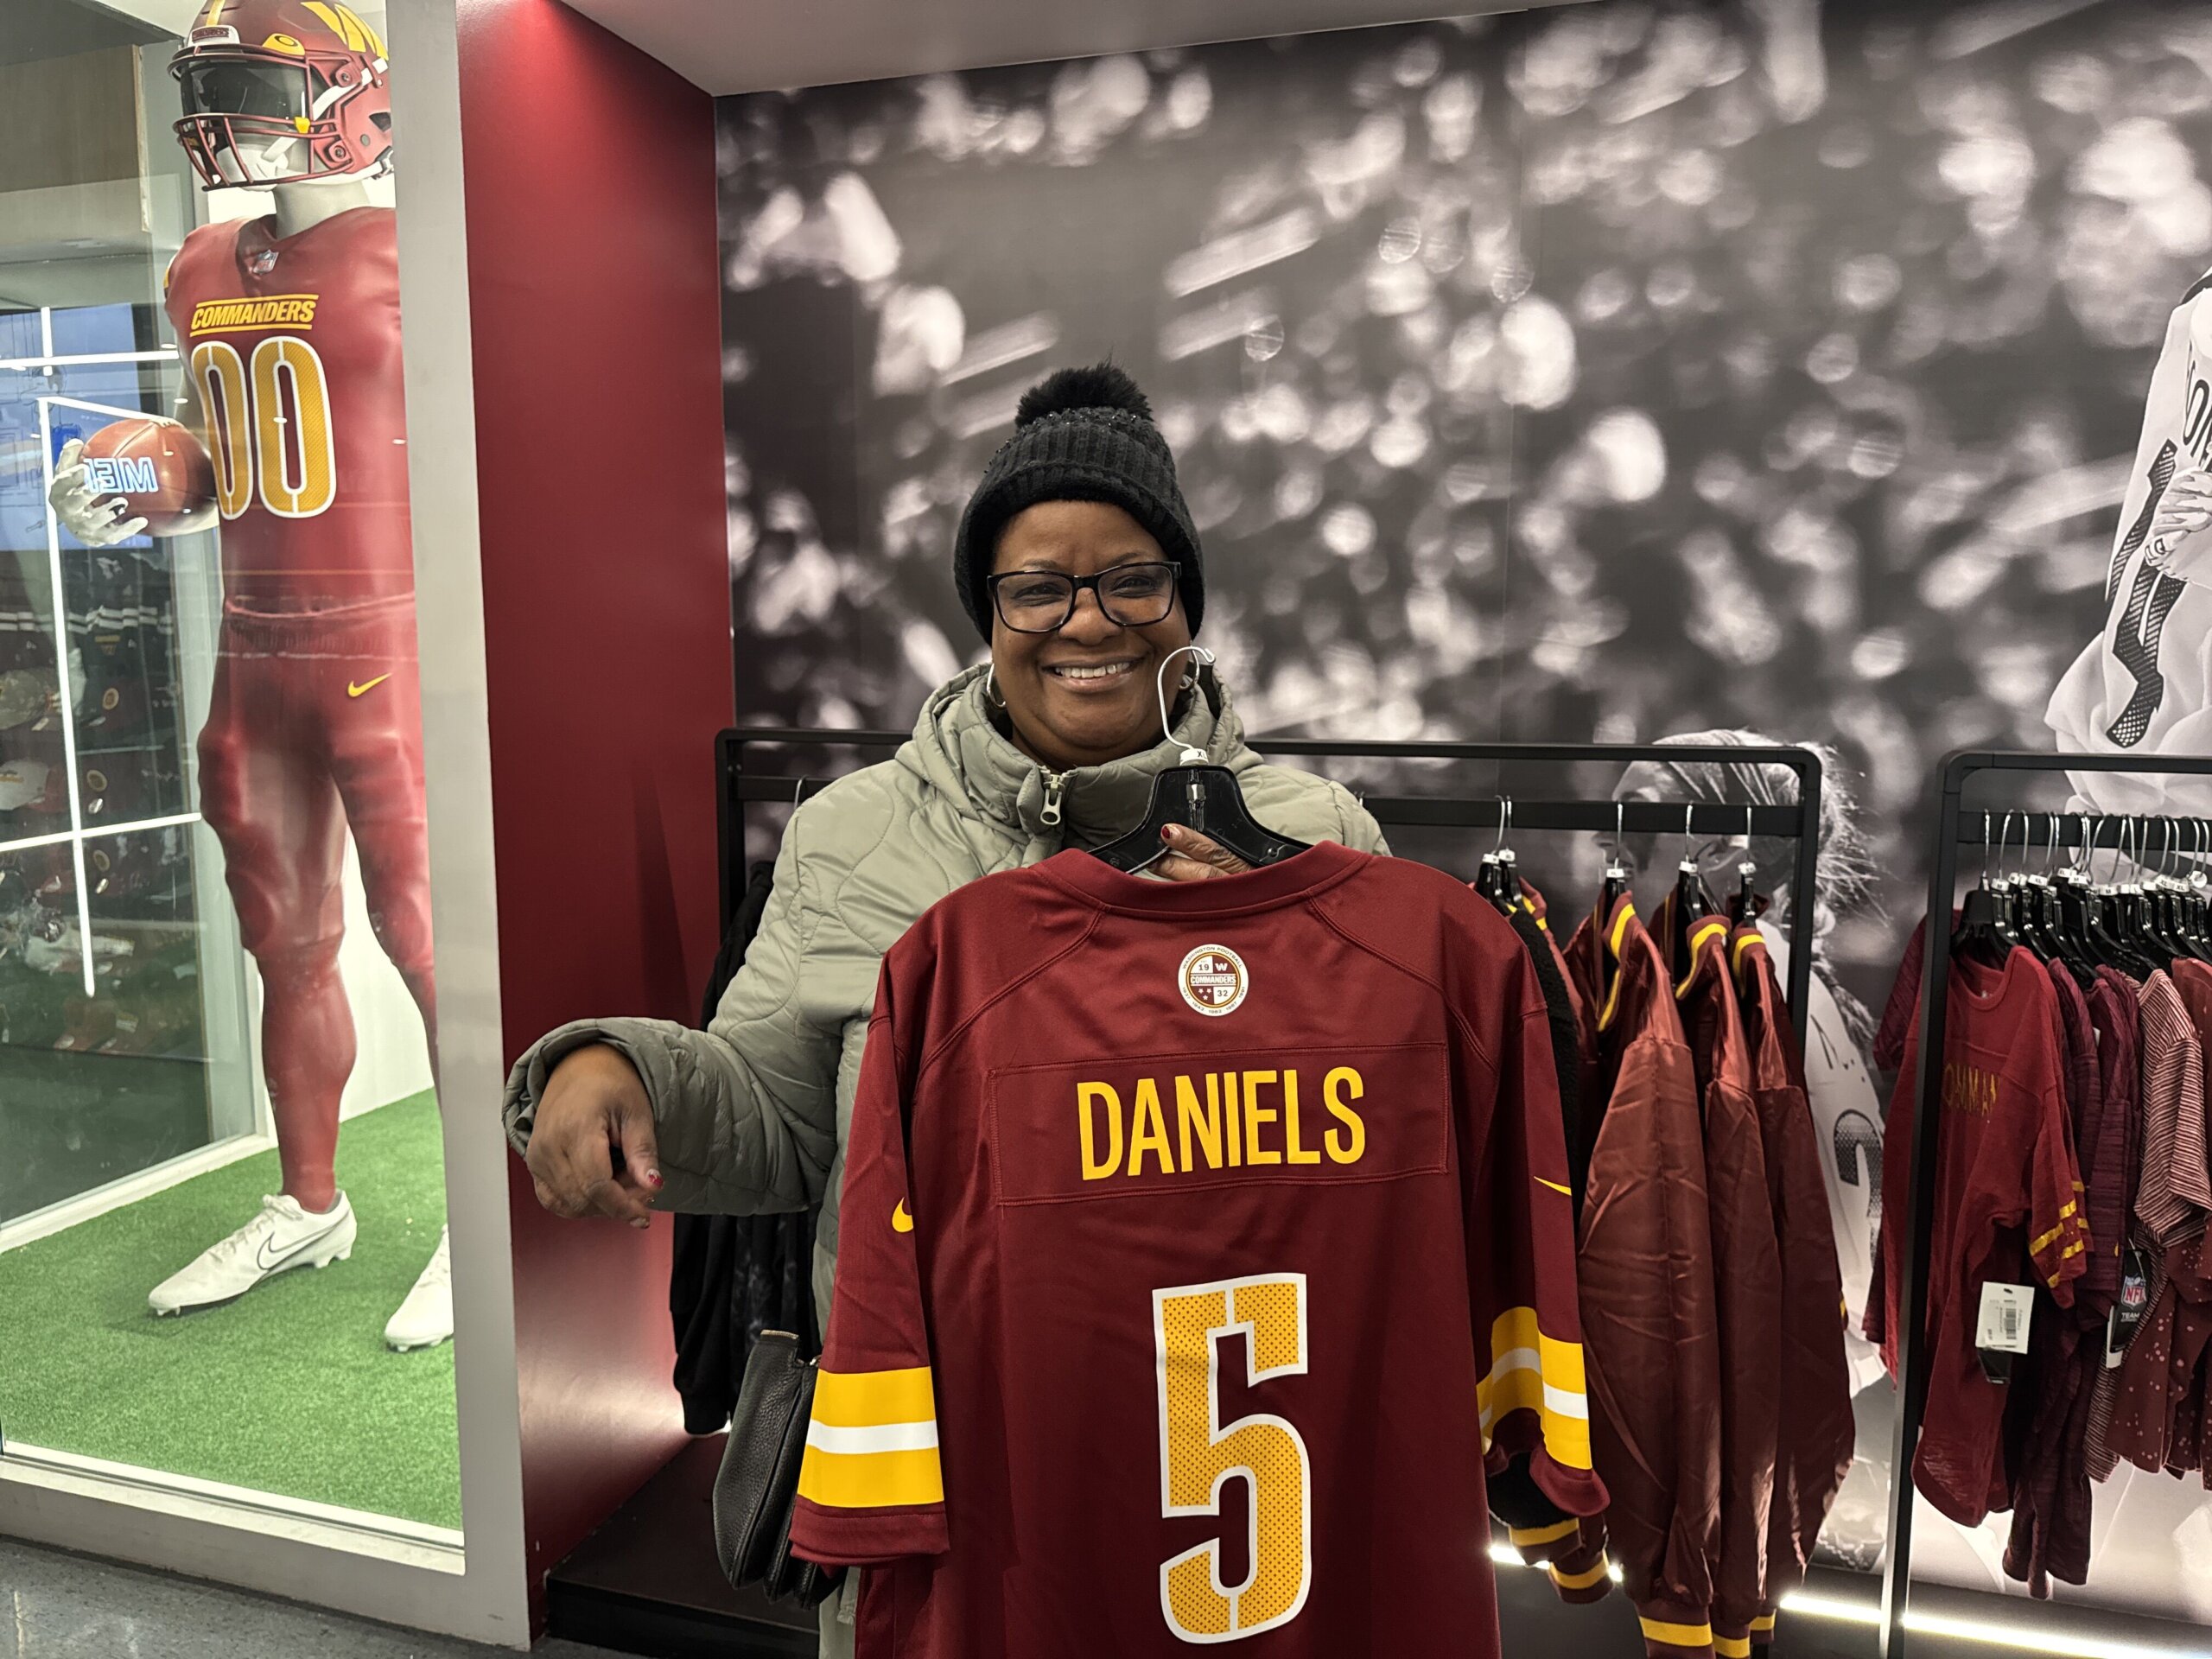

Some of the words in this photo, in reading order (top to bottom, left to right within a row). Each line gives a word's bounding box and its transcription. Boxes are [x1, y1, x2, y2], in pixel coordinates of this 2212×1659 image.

[190, 300, 317, 330] COMMANDERS
[191, 336, 337, 520] 00
[1182, 946, 1216, 969] WASHINGTON
[1217, 946, 1243, 968] FOOTBALL
[1190, 976, 1236, 984] COMMANDERS
[1077, 1066, 1366, 1182] DANIELS
[2126, 1286, 2145, 1303] NFL
[1152, 1273, 1312, 1644] 5
